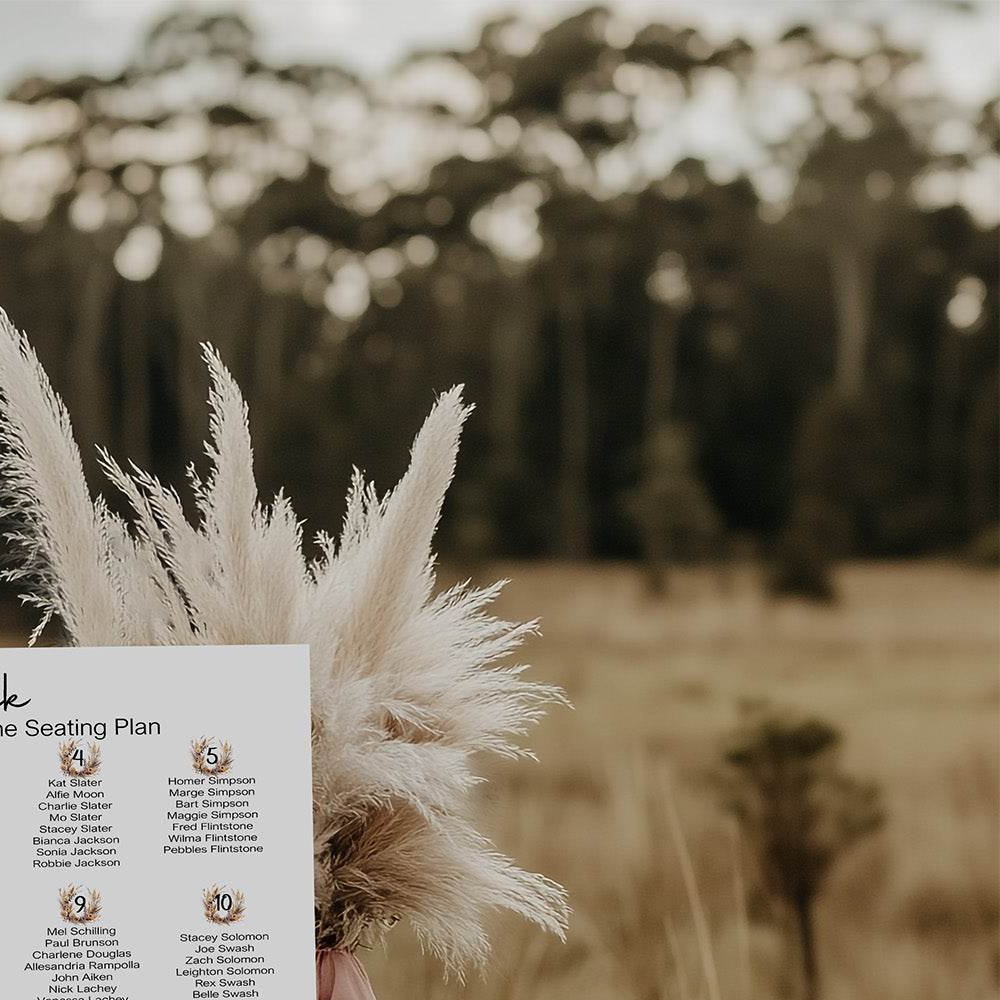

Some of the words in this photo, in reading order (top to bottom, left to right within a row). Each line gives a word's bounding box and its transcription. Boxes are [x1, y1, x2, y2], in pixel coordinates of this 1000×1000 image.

[24, 718, 107, 740] Seating
[115, 718, 161, 735] Plan
[71, 748, 85, 767] 4
[205, 747, 218, 765] 5
[48, 778, 67, 788] Kat
[69, 777, 103, 788] Slater
[167, 777, 206, 786] Homer
[208, 775, 256, 787] Simpson
[45, 790, 70, 800] Alfie
[72, 790, 105, 799] Moon
[168, 788, 205, 799] Marge
[207, 787, 256, 798] Simpson
[37, 801, 78, 811] Charlie
[80, 801, 113, 811] Slater
[175, 799, 199, 809] Bart
[201, 799, 249, 810] Simpson
[49, 813, 68, 822] Mo
[69, 812, 103, 822] Slater
[167, 810, 208, 822] Maggie
[210, 810, 259, 821] Simpson
[39, 824, 78, 836] Stacey
[80, 824, 113, 833] Slater
[172, 822, 198, 832] Fred
[200, 822, 254, 831] Flintstone
[74, 895, 86, 914] 9
[214, 894, 232, 912] 10
[46, 927, 67, 936] Mel
[70, 926, 117, 937] Schilling
[44, 938, 70, 948] Paul
[72, 938, 119, 948] Brunson
[179, 933, 219, 944] Stacey
[220, 932, 270, 942] Solomon
[194, 944, 216, 954] Joe
[217, 943, 255, 954] Swash
[32, 950, 84, 960] Charlene
[86, 949, 132, 960] Douglas
[185, 955, 214, 965] Zach
[216, 955, 265, 965] Solomon
[23, 961, 86, 972] Allesandria
[88, 960, 141, 971] Rampolla
[51, 973, 80, 983] John
[81, 972, 113, 982] Aiken
[175, 967, 224, 979] Leighton
[226, 966, 275, 976] Solomon
[195, 978, 217, 988] Rex
[218, 978, 256, 988] Swash
